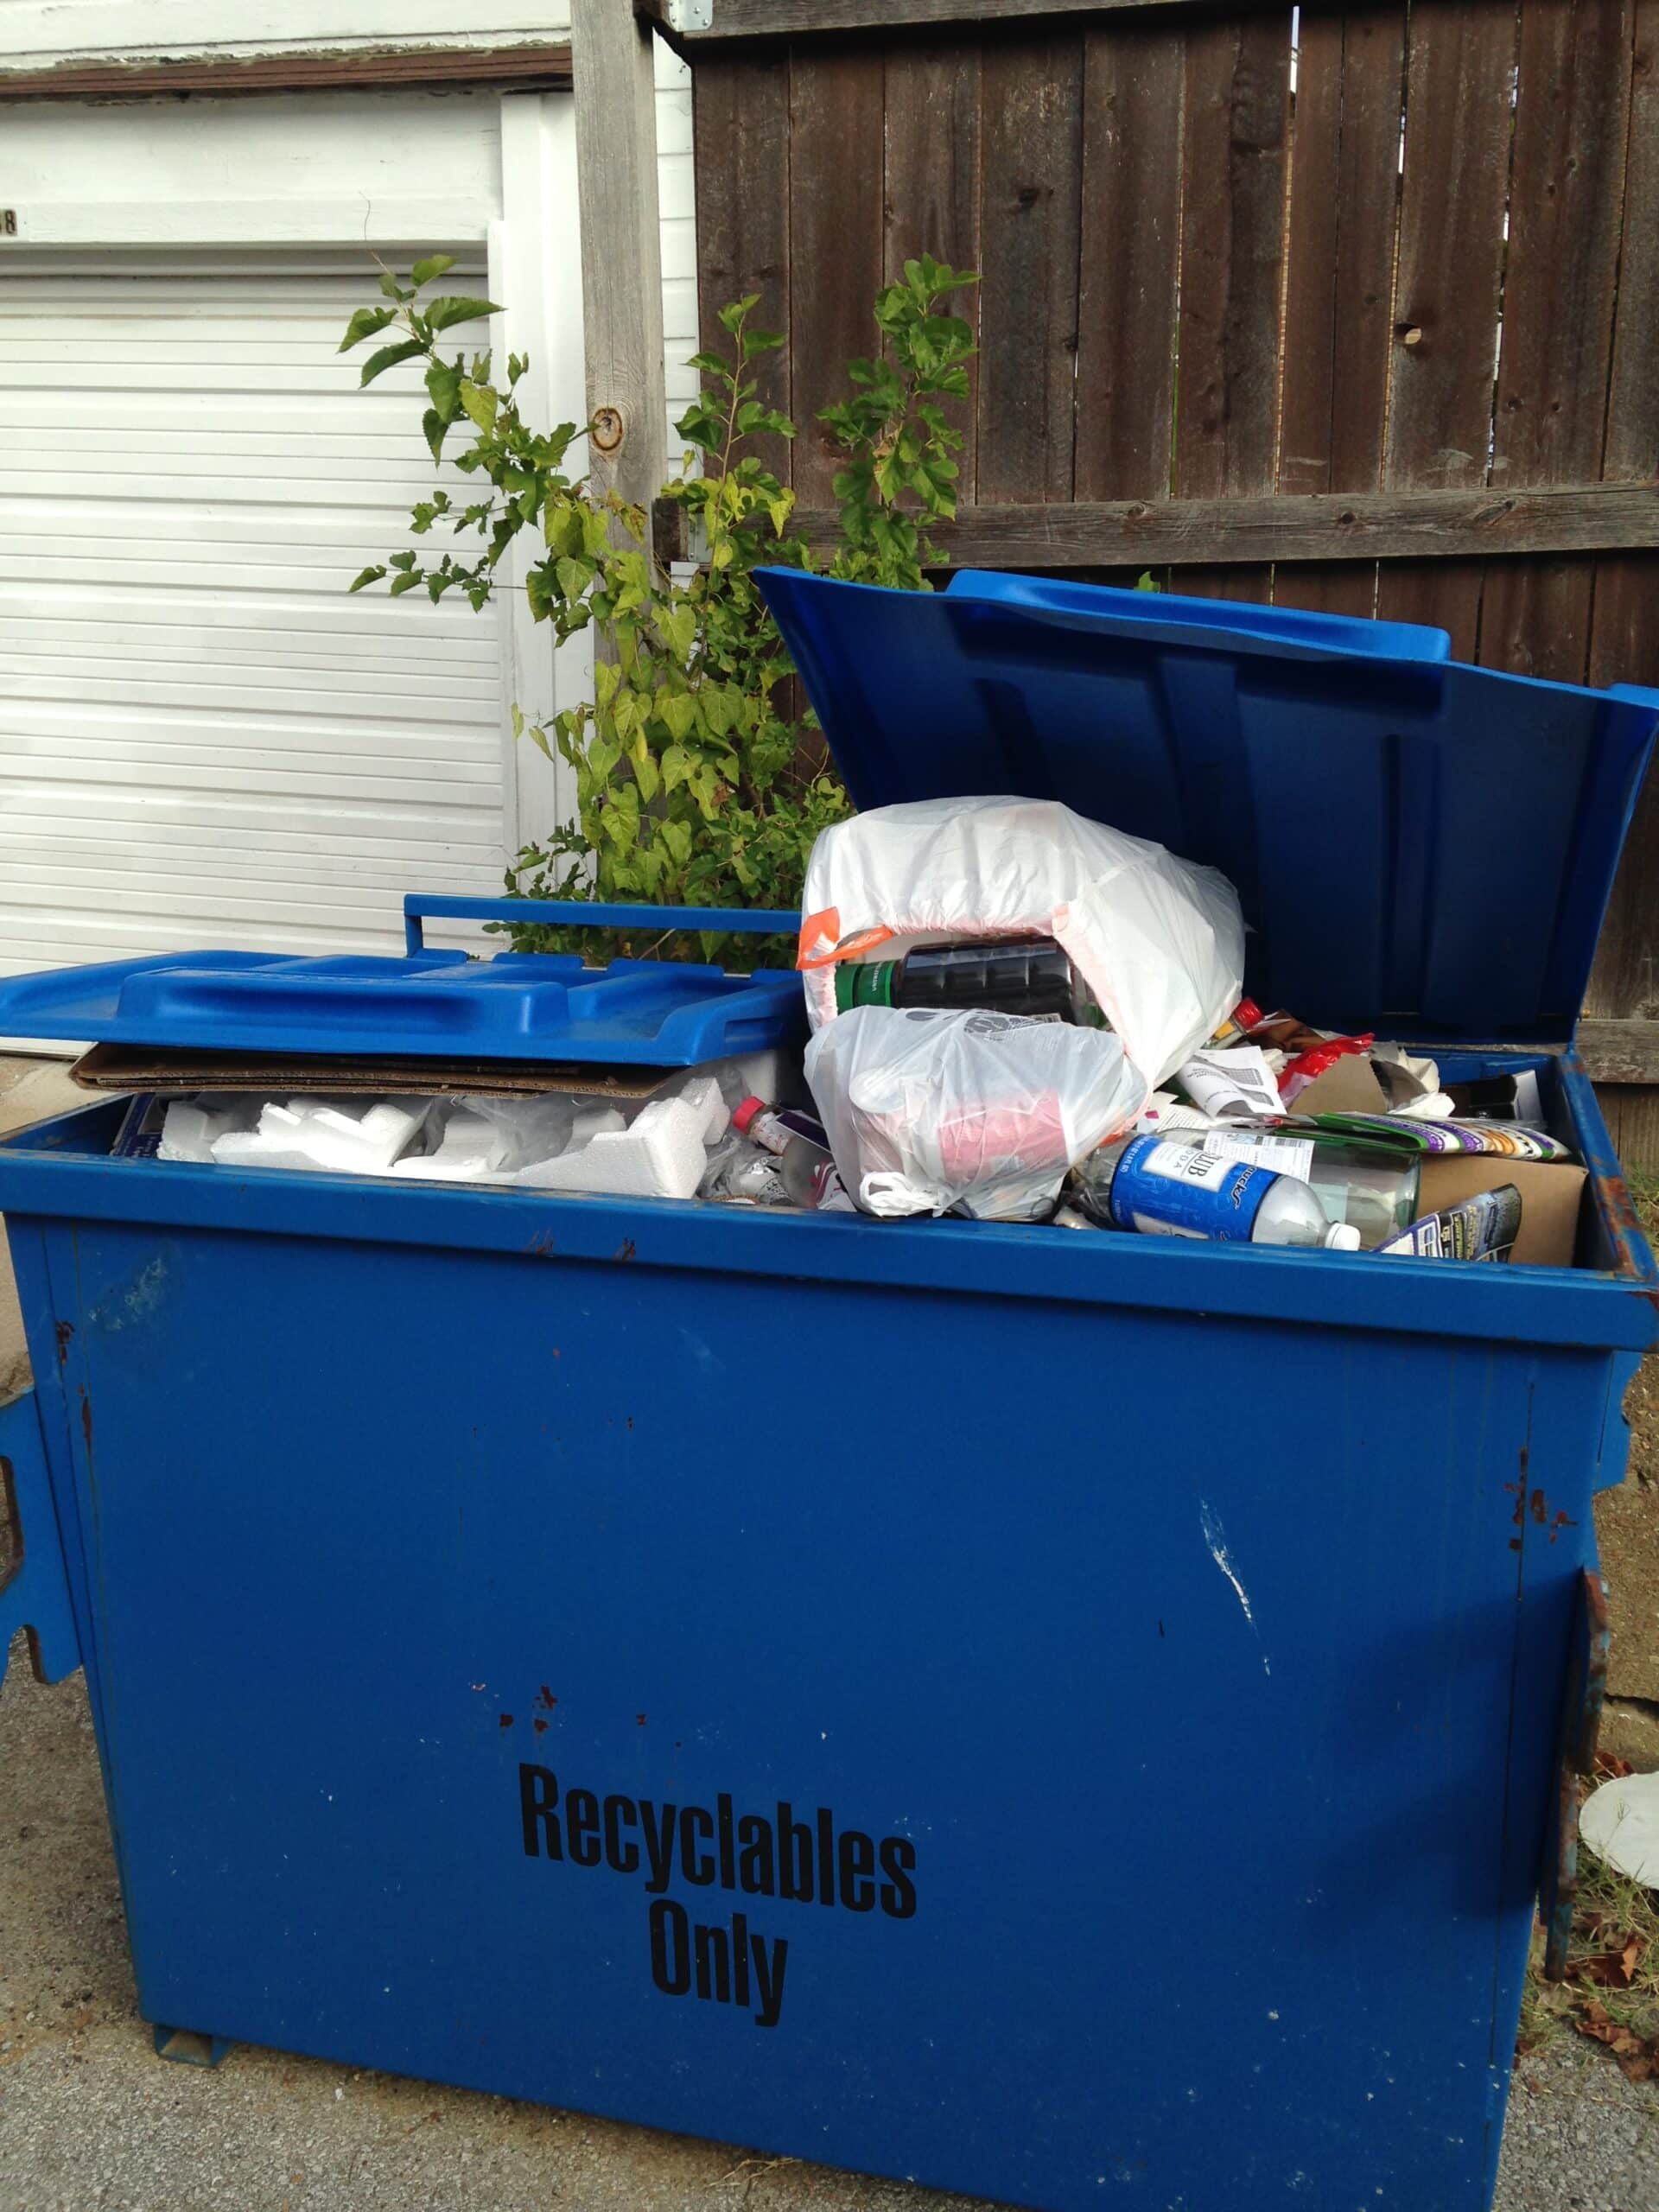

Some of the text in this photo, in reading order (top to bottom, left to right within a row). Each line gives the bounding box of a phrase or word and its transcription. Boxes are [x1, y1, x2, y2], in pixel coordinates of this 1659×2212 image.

[1188, 1152, 1224, 1177] LUB
[1231, 1166, 1258, 1210] nucks
[518, 1763, 918, 1919] Recyclables
[649, 1898, 788, 2027] Only
